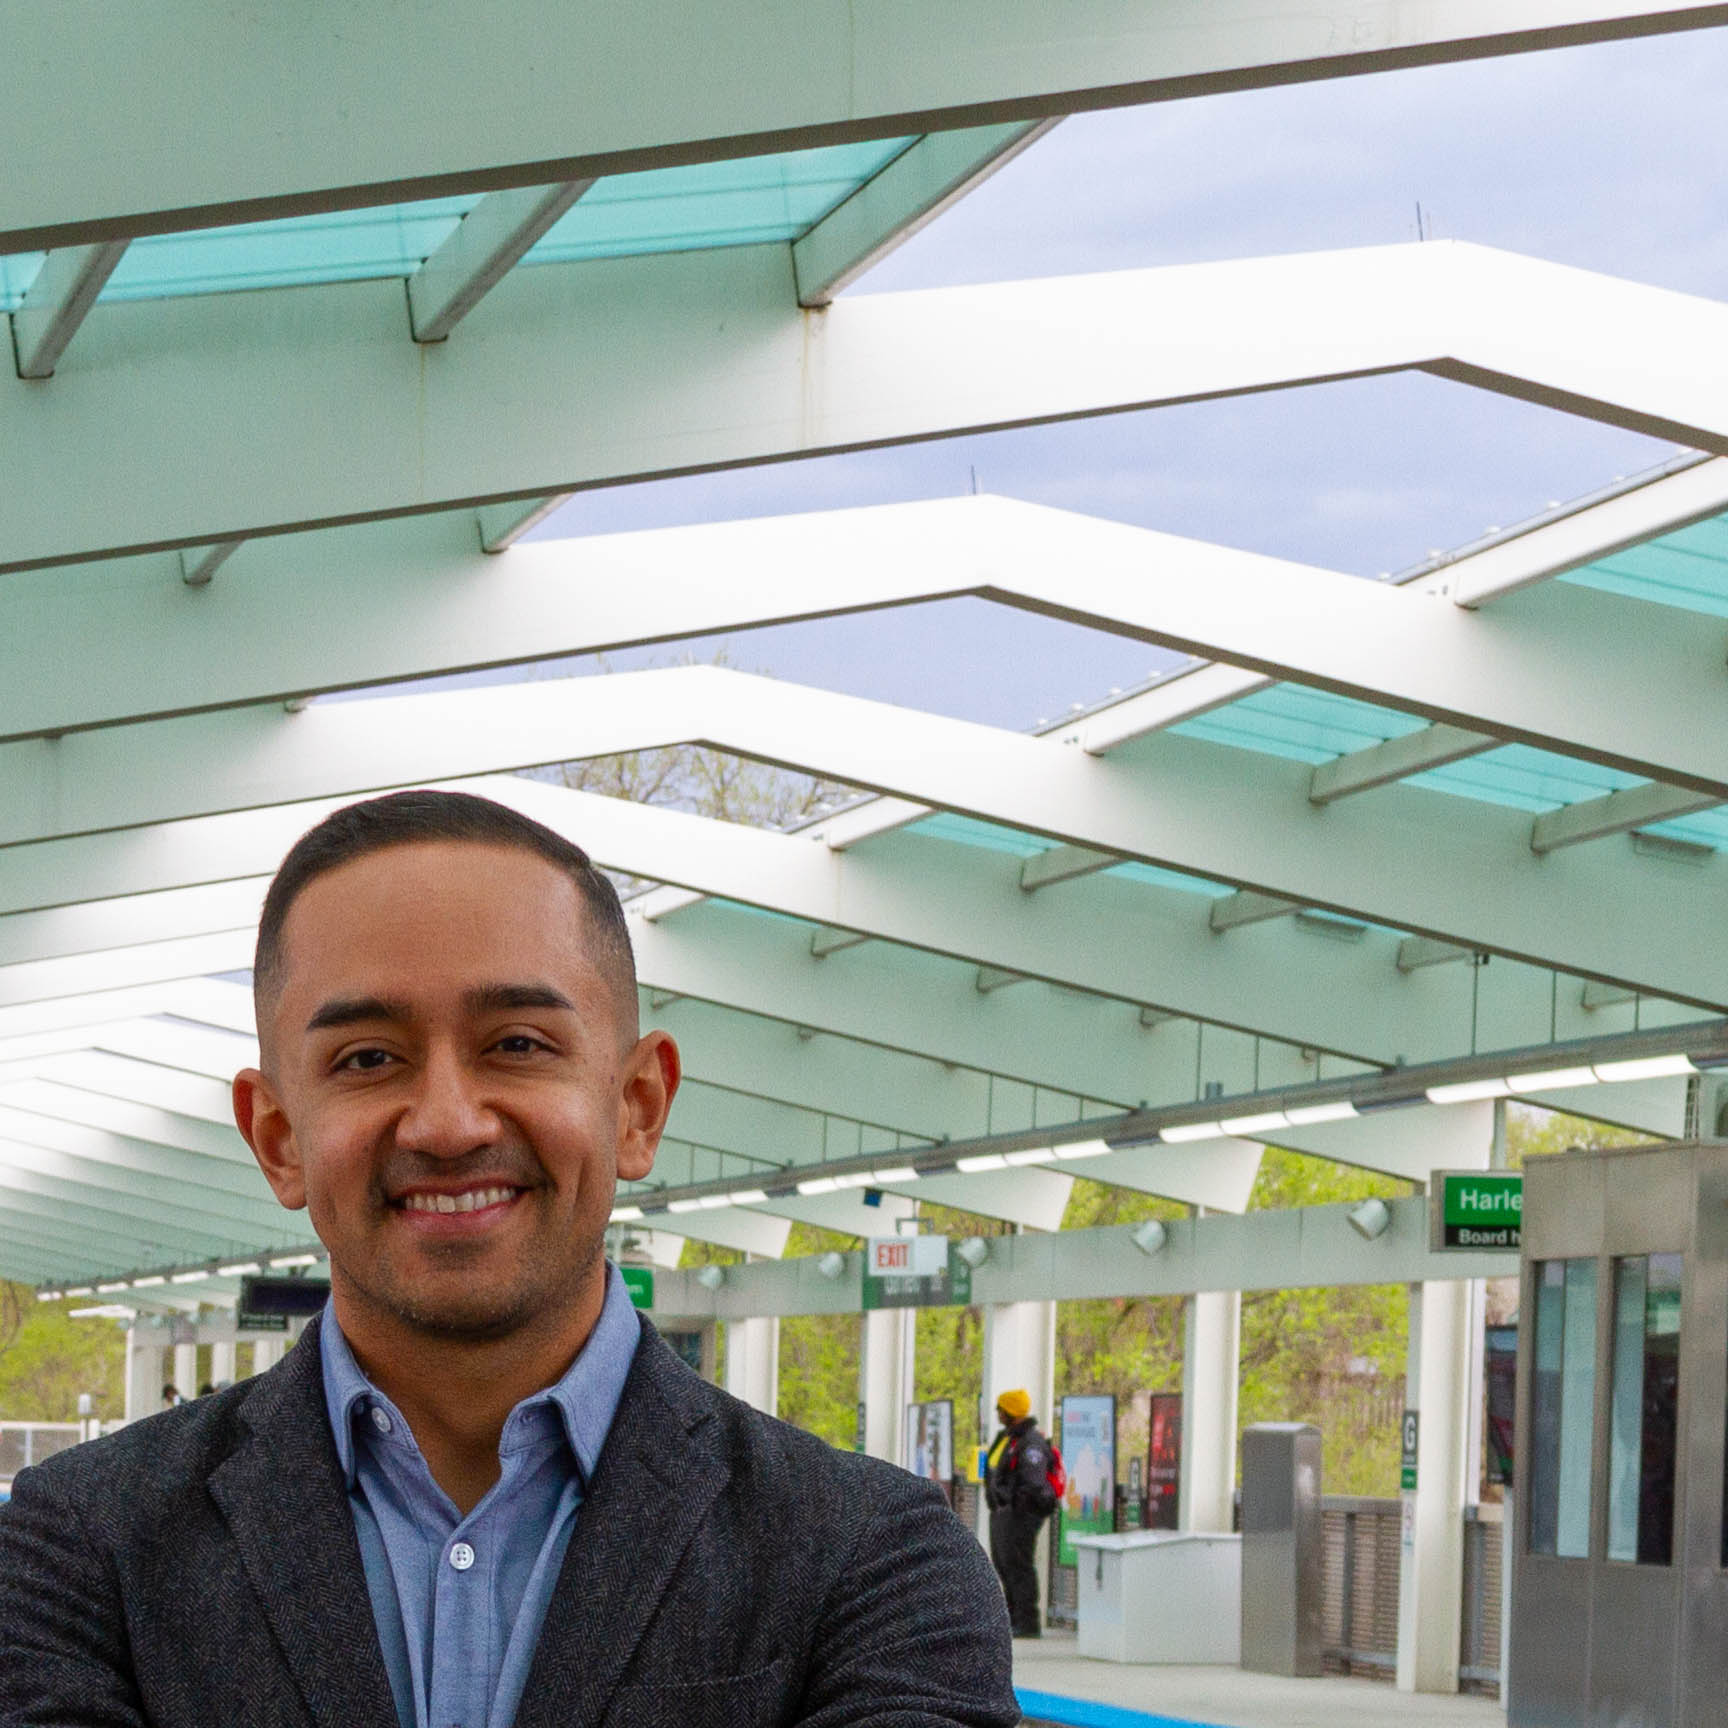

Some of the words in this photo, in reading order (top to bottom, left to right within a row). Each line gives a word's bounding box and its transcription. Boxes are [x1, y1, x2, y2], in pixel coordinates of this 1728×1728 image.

[1459, 1228, 1507, 1244] Board
[877, 1244, 909, 1268] EXIT
[1405, 1416, 1416, 1450] G
